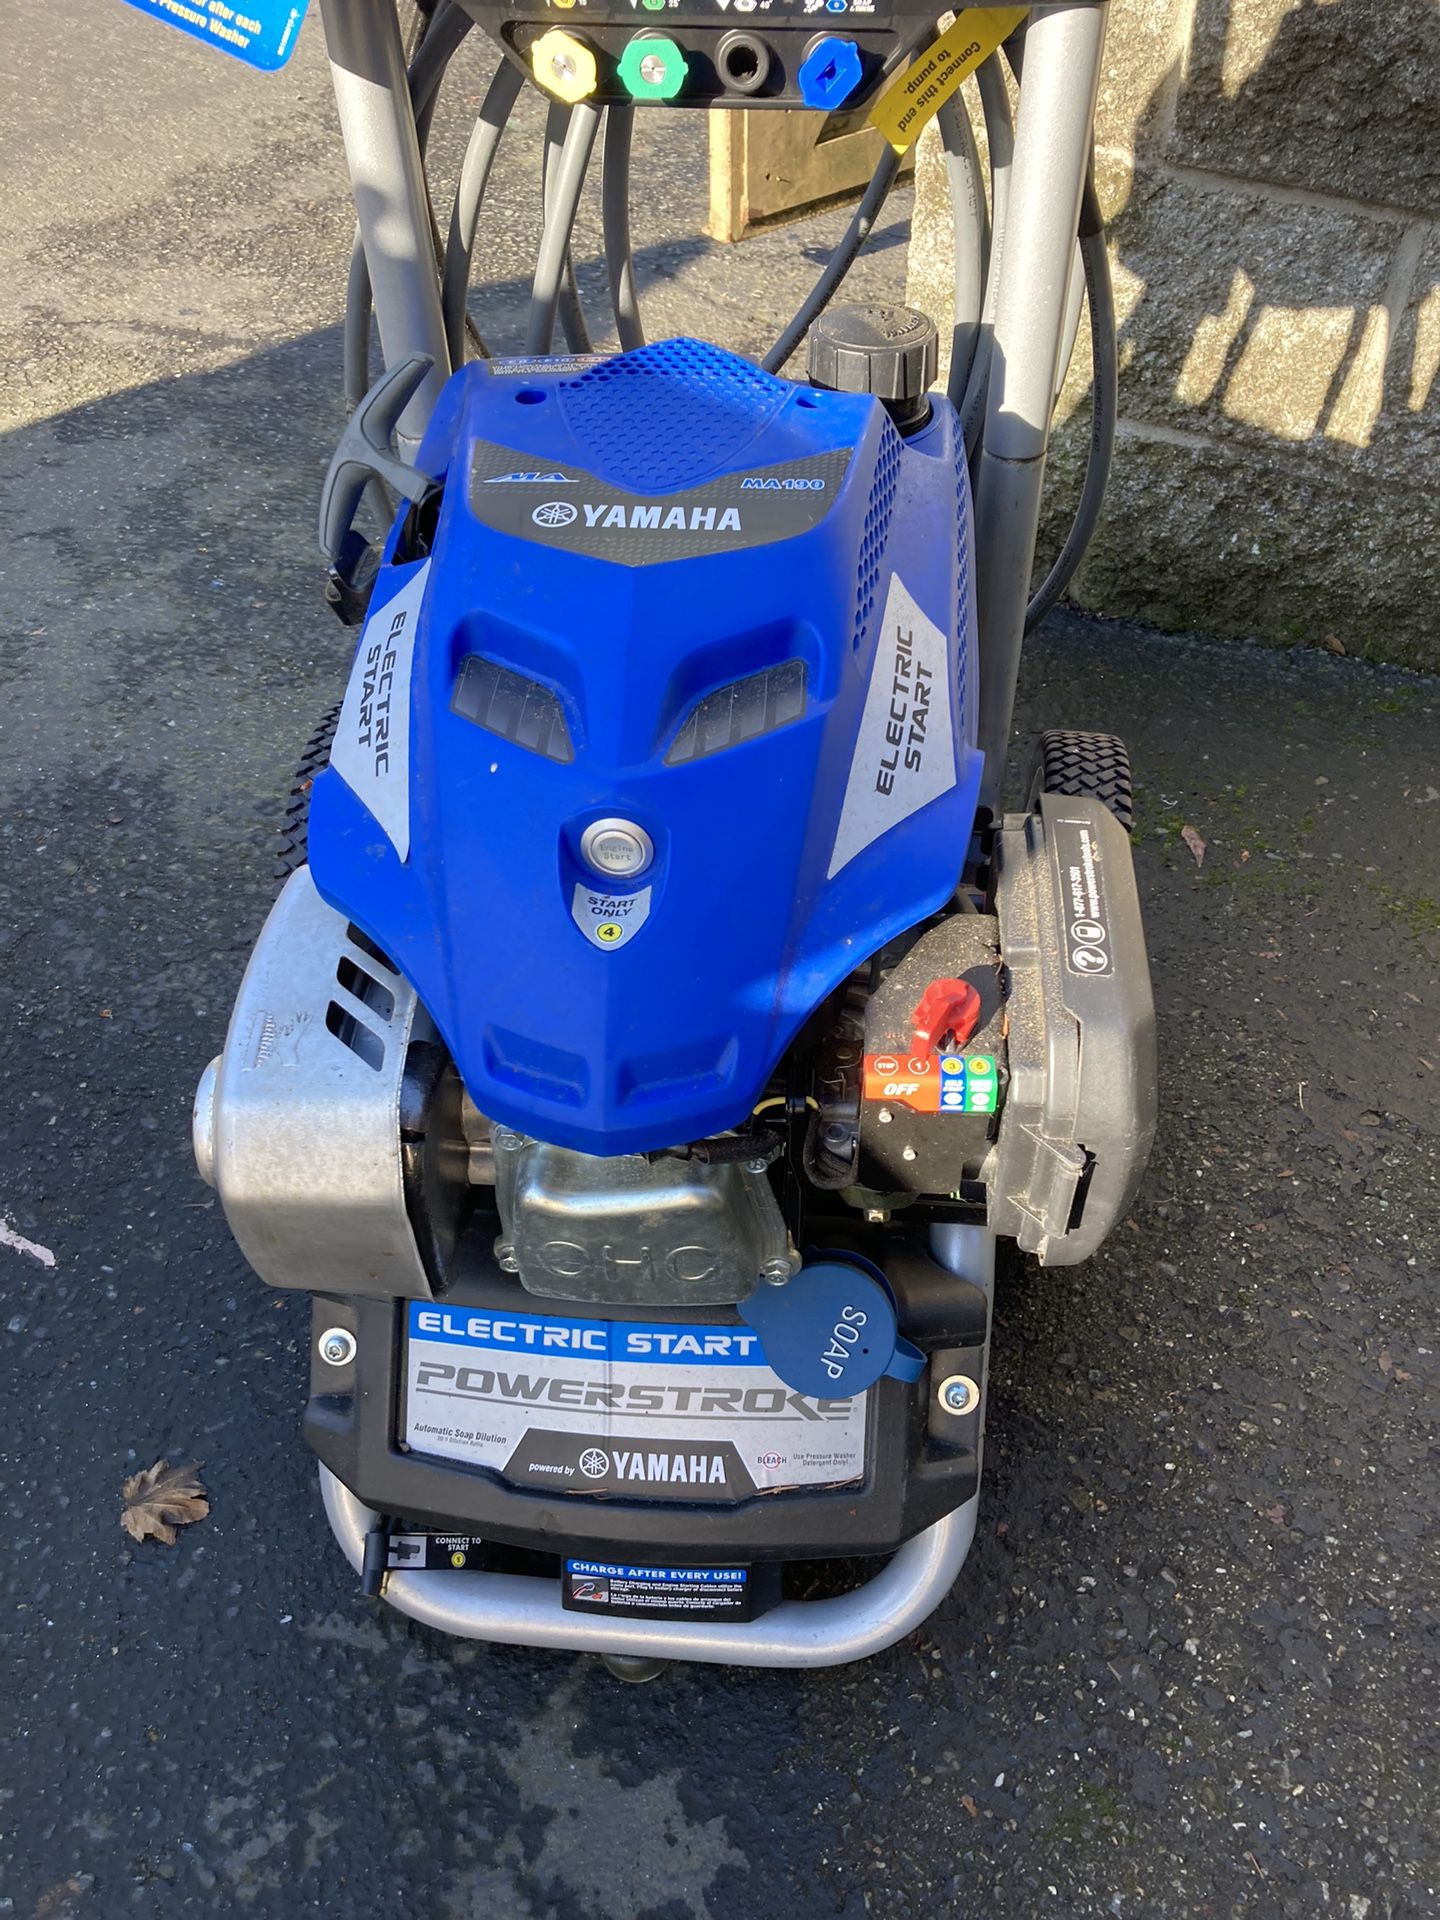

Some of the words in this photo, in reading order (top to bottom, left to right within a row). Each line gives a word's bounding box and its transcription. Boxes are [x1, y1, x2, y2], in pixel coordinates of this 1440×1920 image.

[208, 0, 235, 21] after
[235, 14, 262, 35] each
[209, 18, 250, 49] Washer
[936, 41, 981, 86] Connect
[938, 49, 951, 62] to
[903, 60, 937, 95] pump.
[916, 87, 939, 108] this
[897, 109, 917, 133] end
[740, 477, 825, 490] MA190
[584, 504, 742, 531] YAMAHA
[358, 644, 382, 747] START
[376, 610, 407, 777] ELECTRIC
[876, 625, 913, 796] ELECTRIC
[904, 661, 933, 772] START
[600, 844, 634, 853] Engine
[603, 852, 632, 861] Start
[587, 896, 637, 909] START
[591, 907, 633, 918] ONLY
[603, 927, 615, 937] 4
[876, 1062, 896, 1070] STOP
[915, 1061, 922, 1070] 1
[949, 1061, 956, 1070] 3
[884, 1083, 920, 1096] OFF
[418, 1311, 607, 1351] ELECTRIC
[627, 1333, 757, 1357] START
[820, 1303, 868, 1380] SOAP
[414, 1422, 453, 1436] Automatic
[454, 1429, 474, 1440] Soap
[475, 1432, 507, 1444] Dilution
[528, 1462, 563, 1475] powered
[565, 1465, 576, 1477] by
[612, 1451, 726, 1484] YAMAHA
[757, 1456, 787, 1464] BLEACH
[802, 1459, 832, 1467] Detergent
[572, 1562, 625, 1576] CHARGE
[628, 1569, 666, 1579] AFTER
[670, 1571, 709, 1580] EVERY
[713, 1572, 742, 1580] USE!
